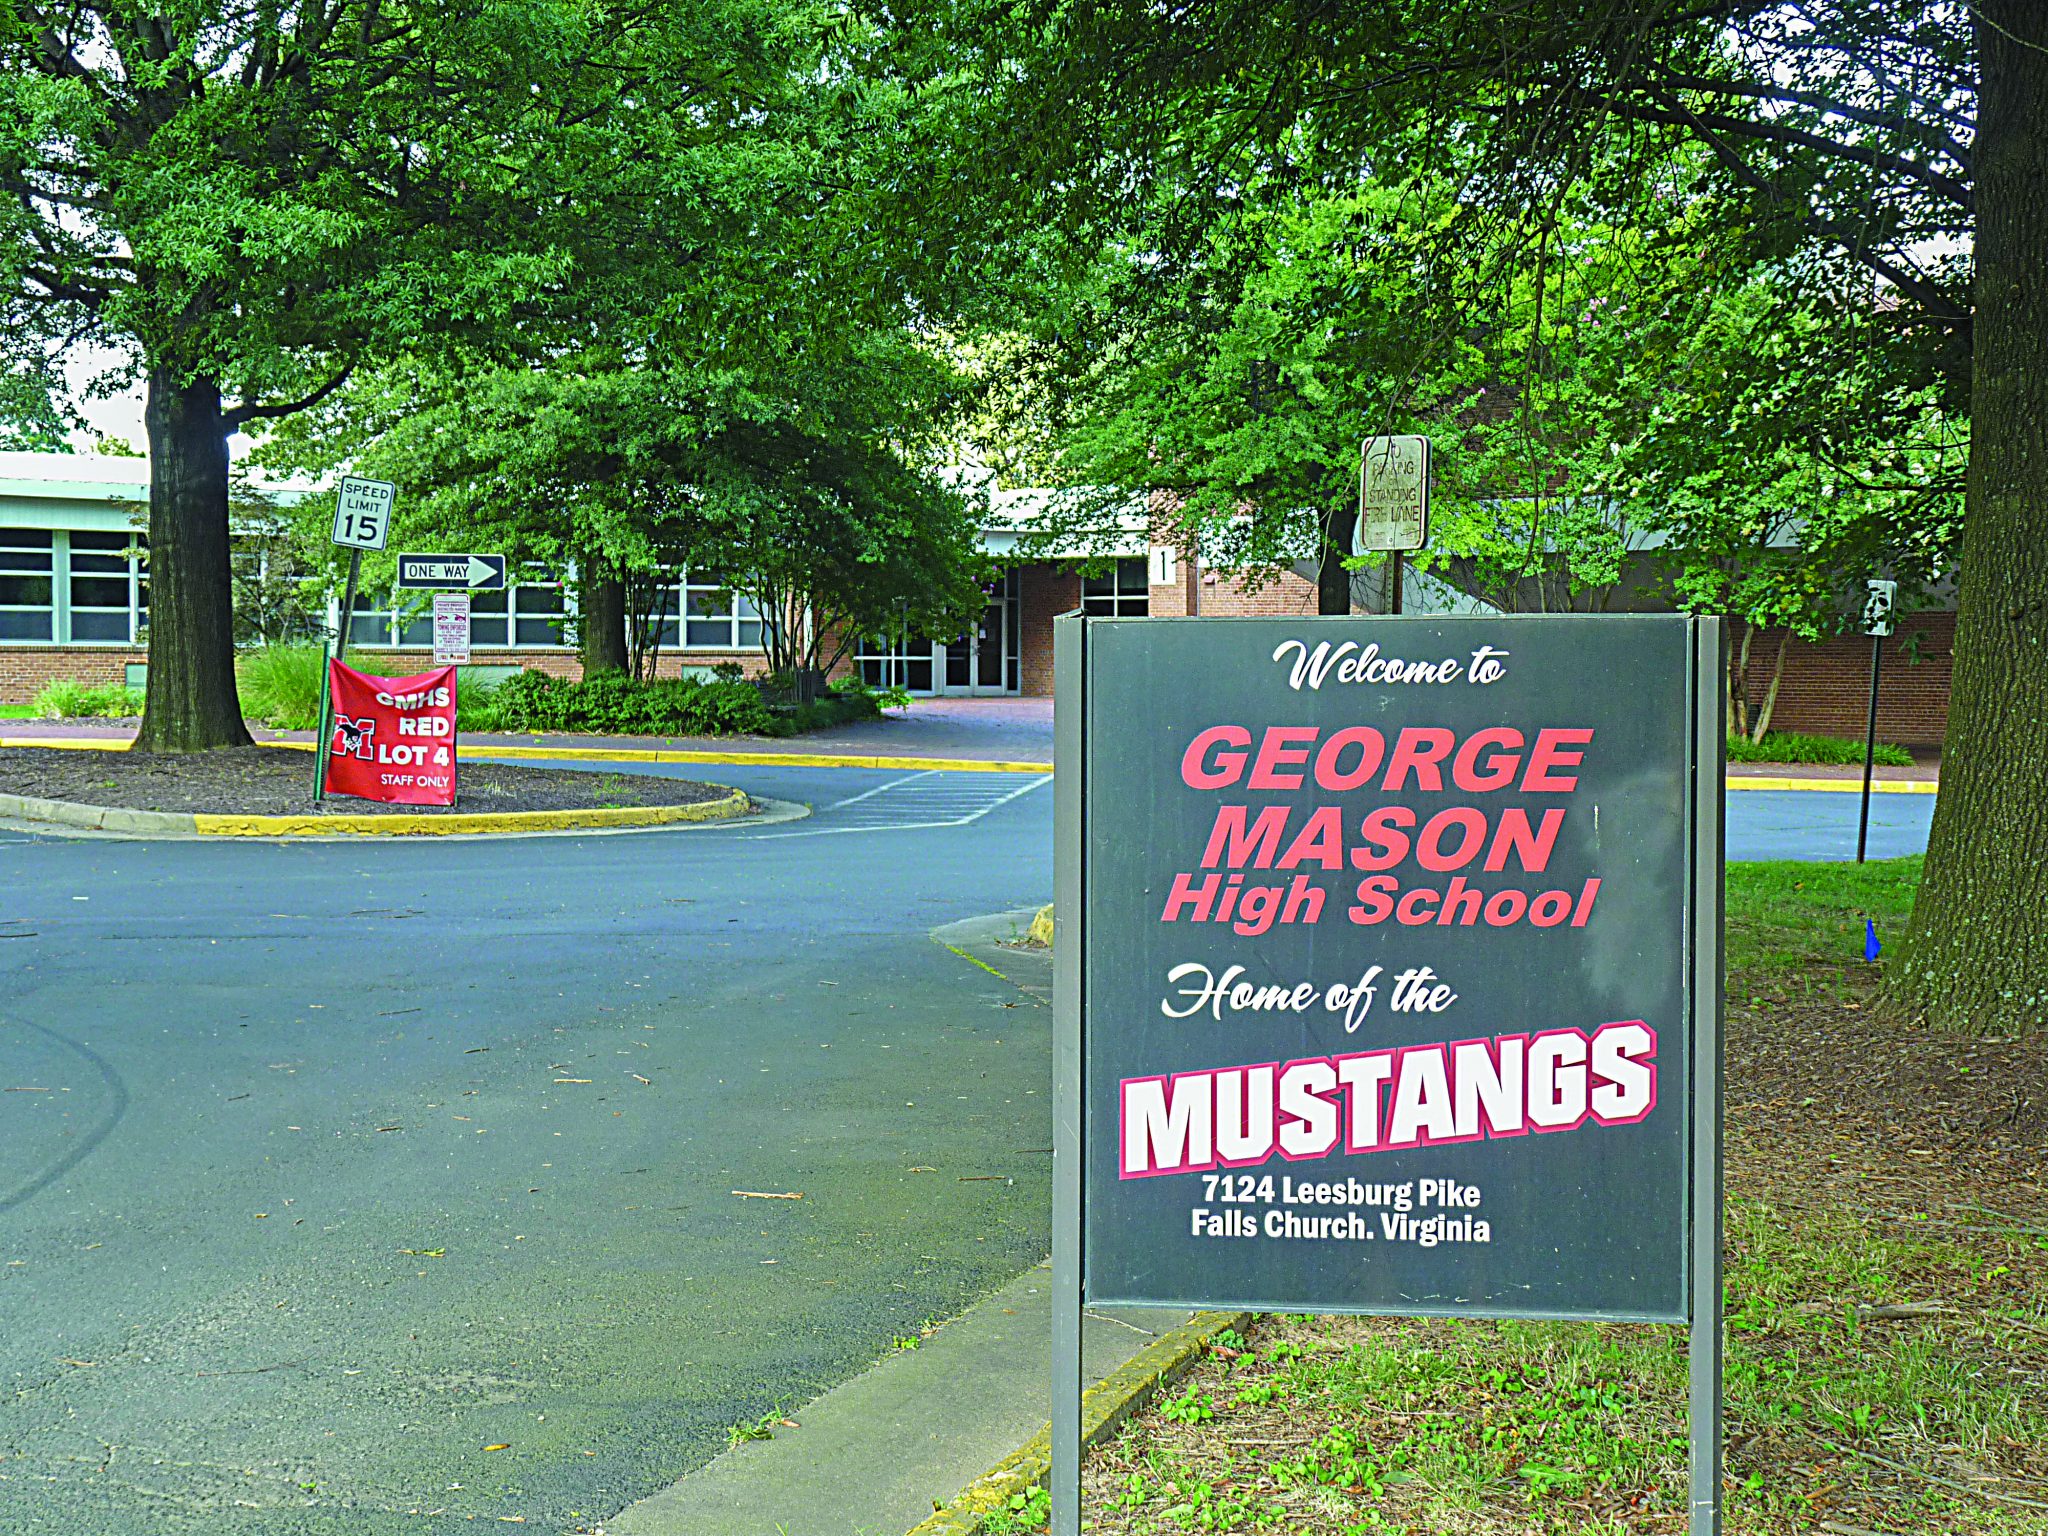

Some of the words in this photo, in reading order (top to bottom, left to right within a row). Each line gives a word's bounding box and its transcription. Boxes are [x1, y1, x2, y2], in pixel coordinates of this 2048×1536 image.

[345, 483, 389, 499] SPEED
[347, 498, 382, 513] LIMIT
[345, 514, 378, 541] 15
[409, 565, 436, 578] ONE
[444, 564, 469, 578] WAY
[1272, 640, 1464, 690] Welcome
[1468, 645, 1510, 684] to
[376, 687, 450, 711] GMHS
[399, 717, 450, 737] RED
[379, 744, 428, 766] LOT
[433, 747, 450, 767] 4
[1181, 725, 1595, 793] GEORGE
[381, 774, 414, 786] STAFF
[417, 775, 450, 787] ONLY
[1200, 805, 1566, 872] MASON
[1161, 873, 1327, 937] High
[1348, 876, 1602, 928] School
[1161, 962, 1321, 1021] Home
[1325, 966, 1384, 1034] of
[1390, 966, 1458, 1013] the
[1120, 1020, 1658, 1180] MUSTANGS
[1203, 1175, 1276, 1203] 7124
[1283, 1177, 1413, 1211] Leesburg
[1419, 1179, 1481, 1207] Pike
[1192, 1209, 1258, 1237] Falls
[1381, 1213, 1490, 1247] Virginia
